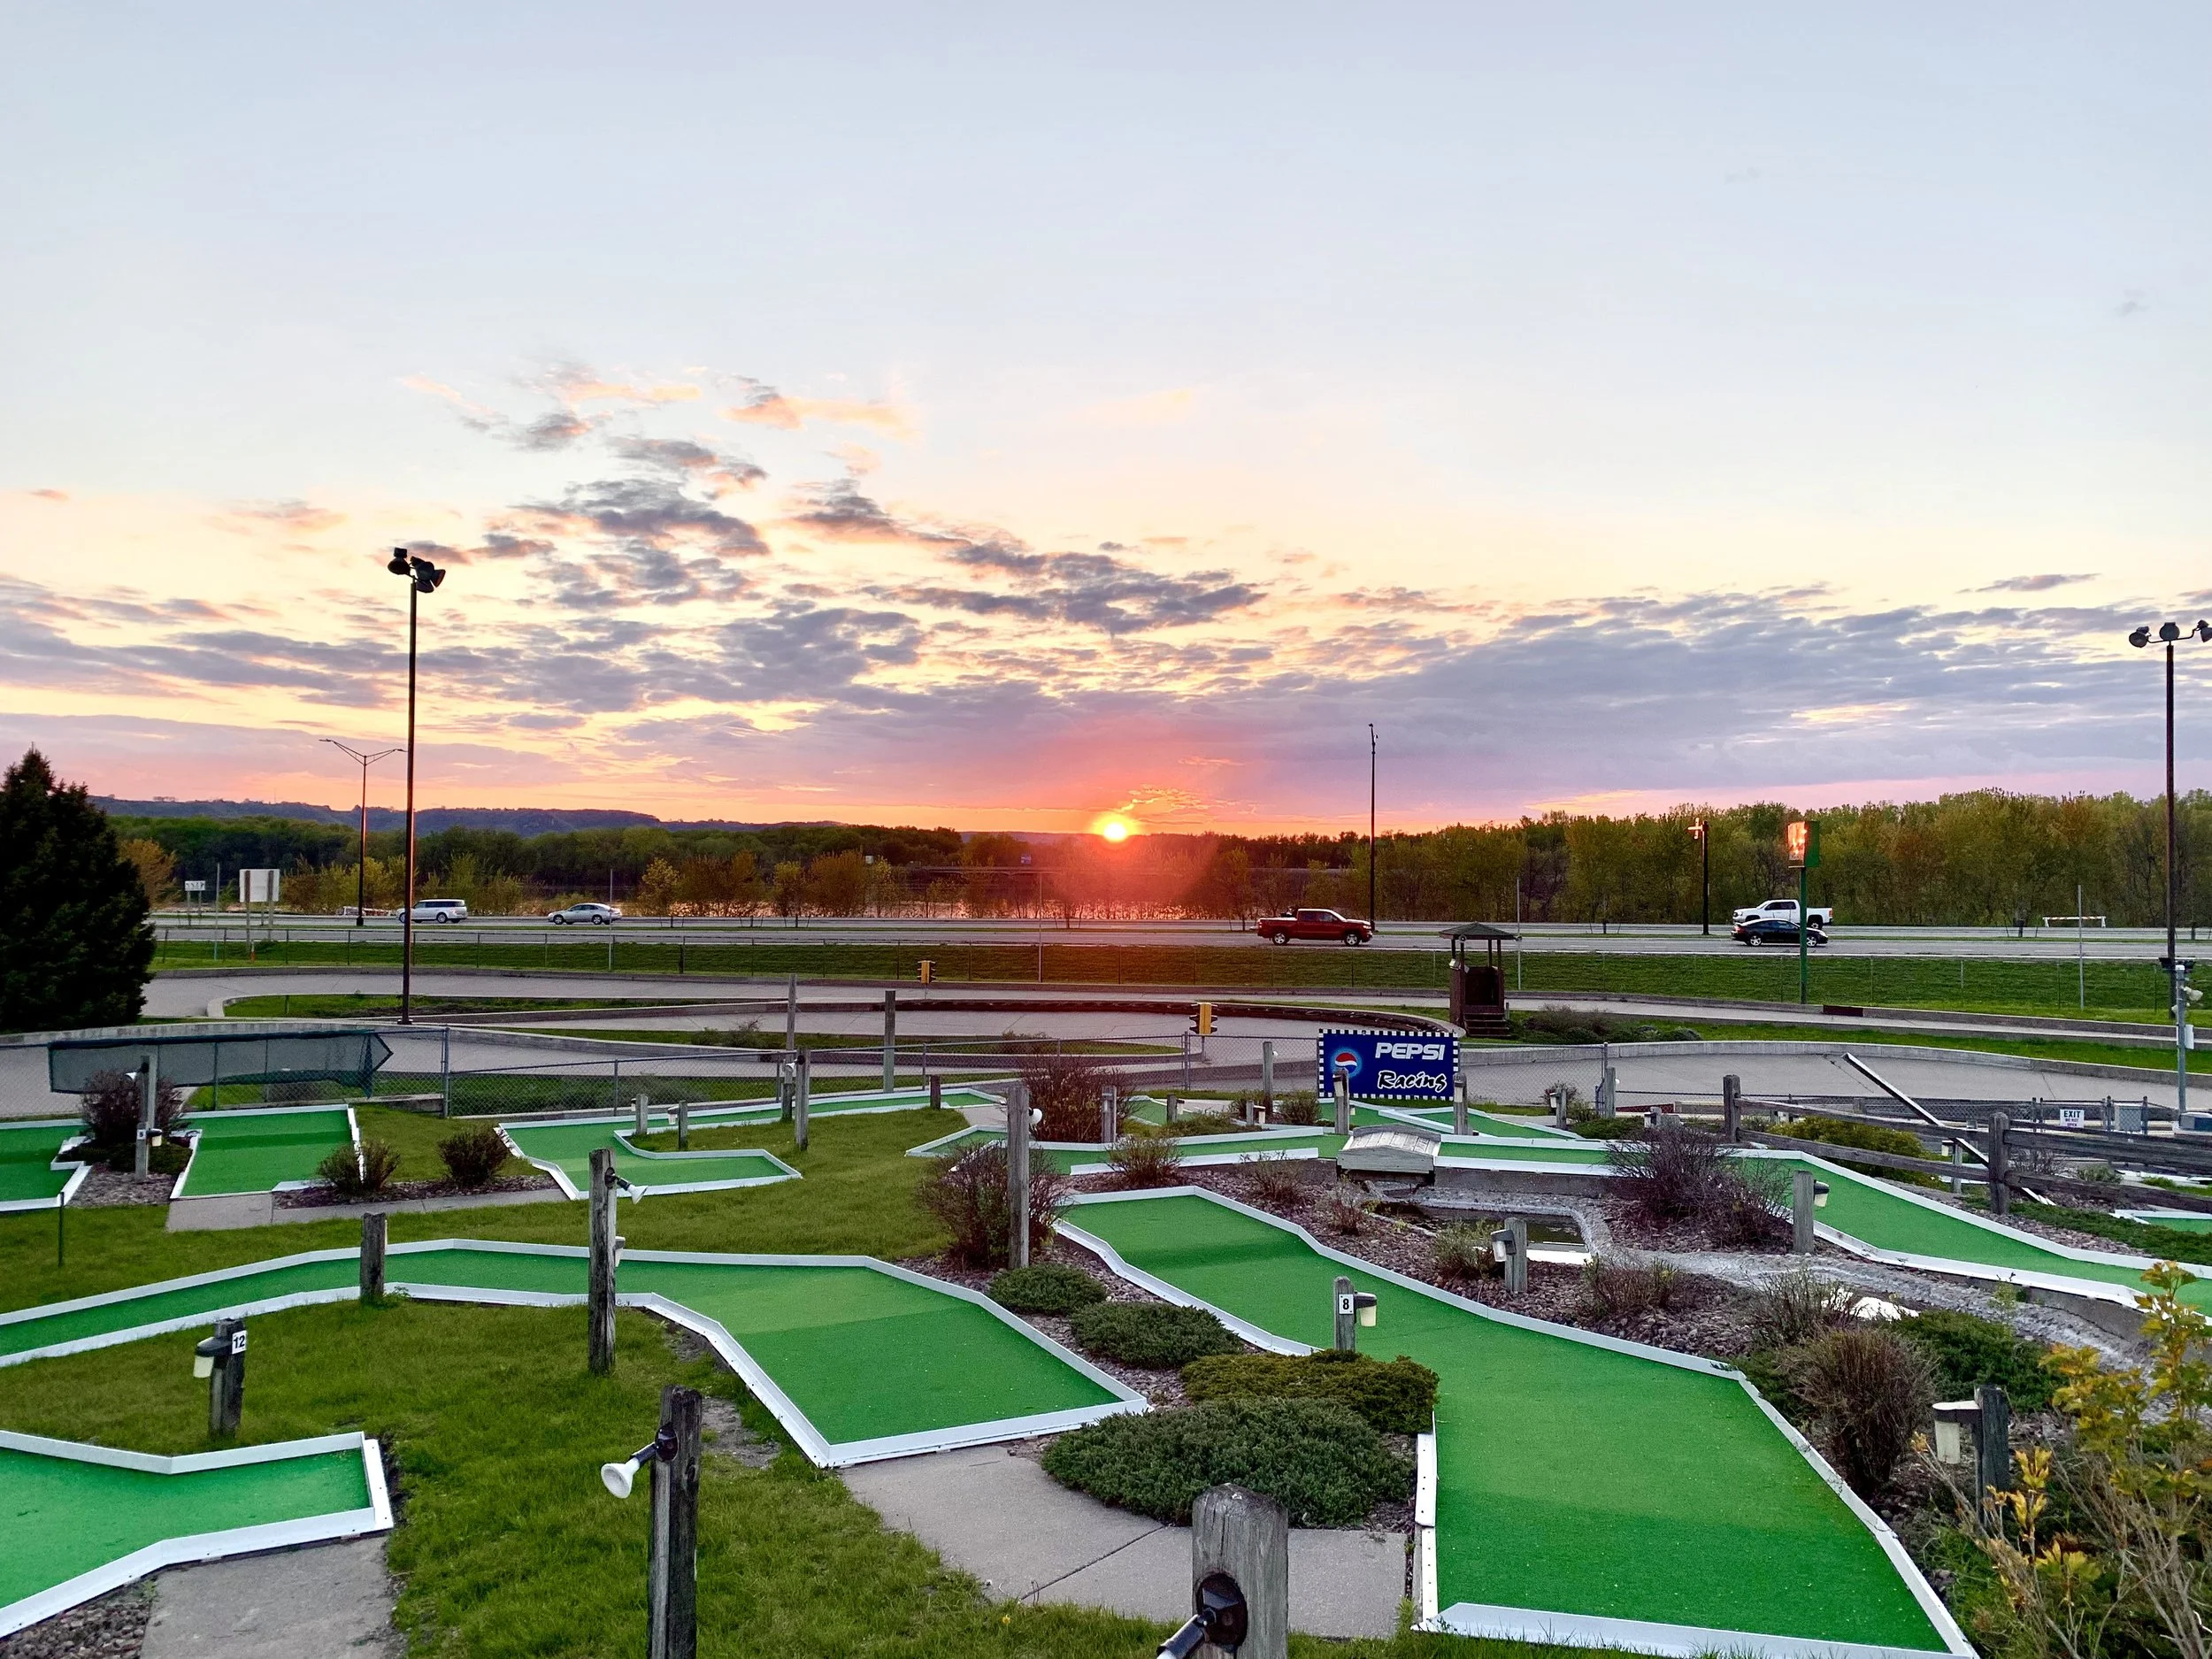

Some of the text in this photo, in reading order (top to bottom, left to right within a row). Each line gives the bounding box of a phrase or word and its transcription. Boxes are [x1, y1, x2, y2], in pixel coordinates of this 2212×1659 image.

[1375, 1042, 1445, 1060] PEPSI
[1378, 1070, 1447, 1093] Racing
[1342, 1298, 1349, 1310] 8
[233, 1335, 245, 1348] 12
